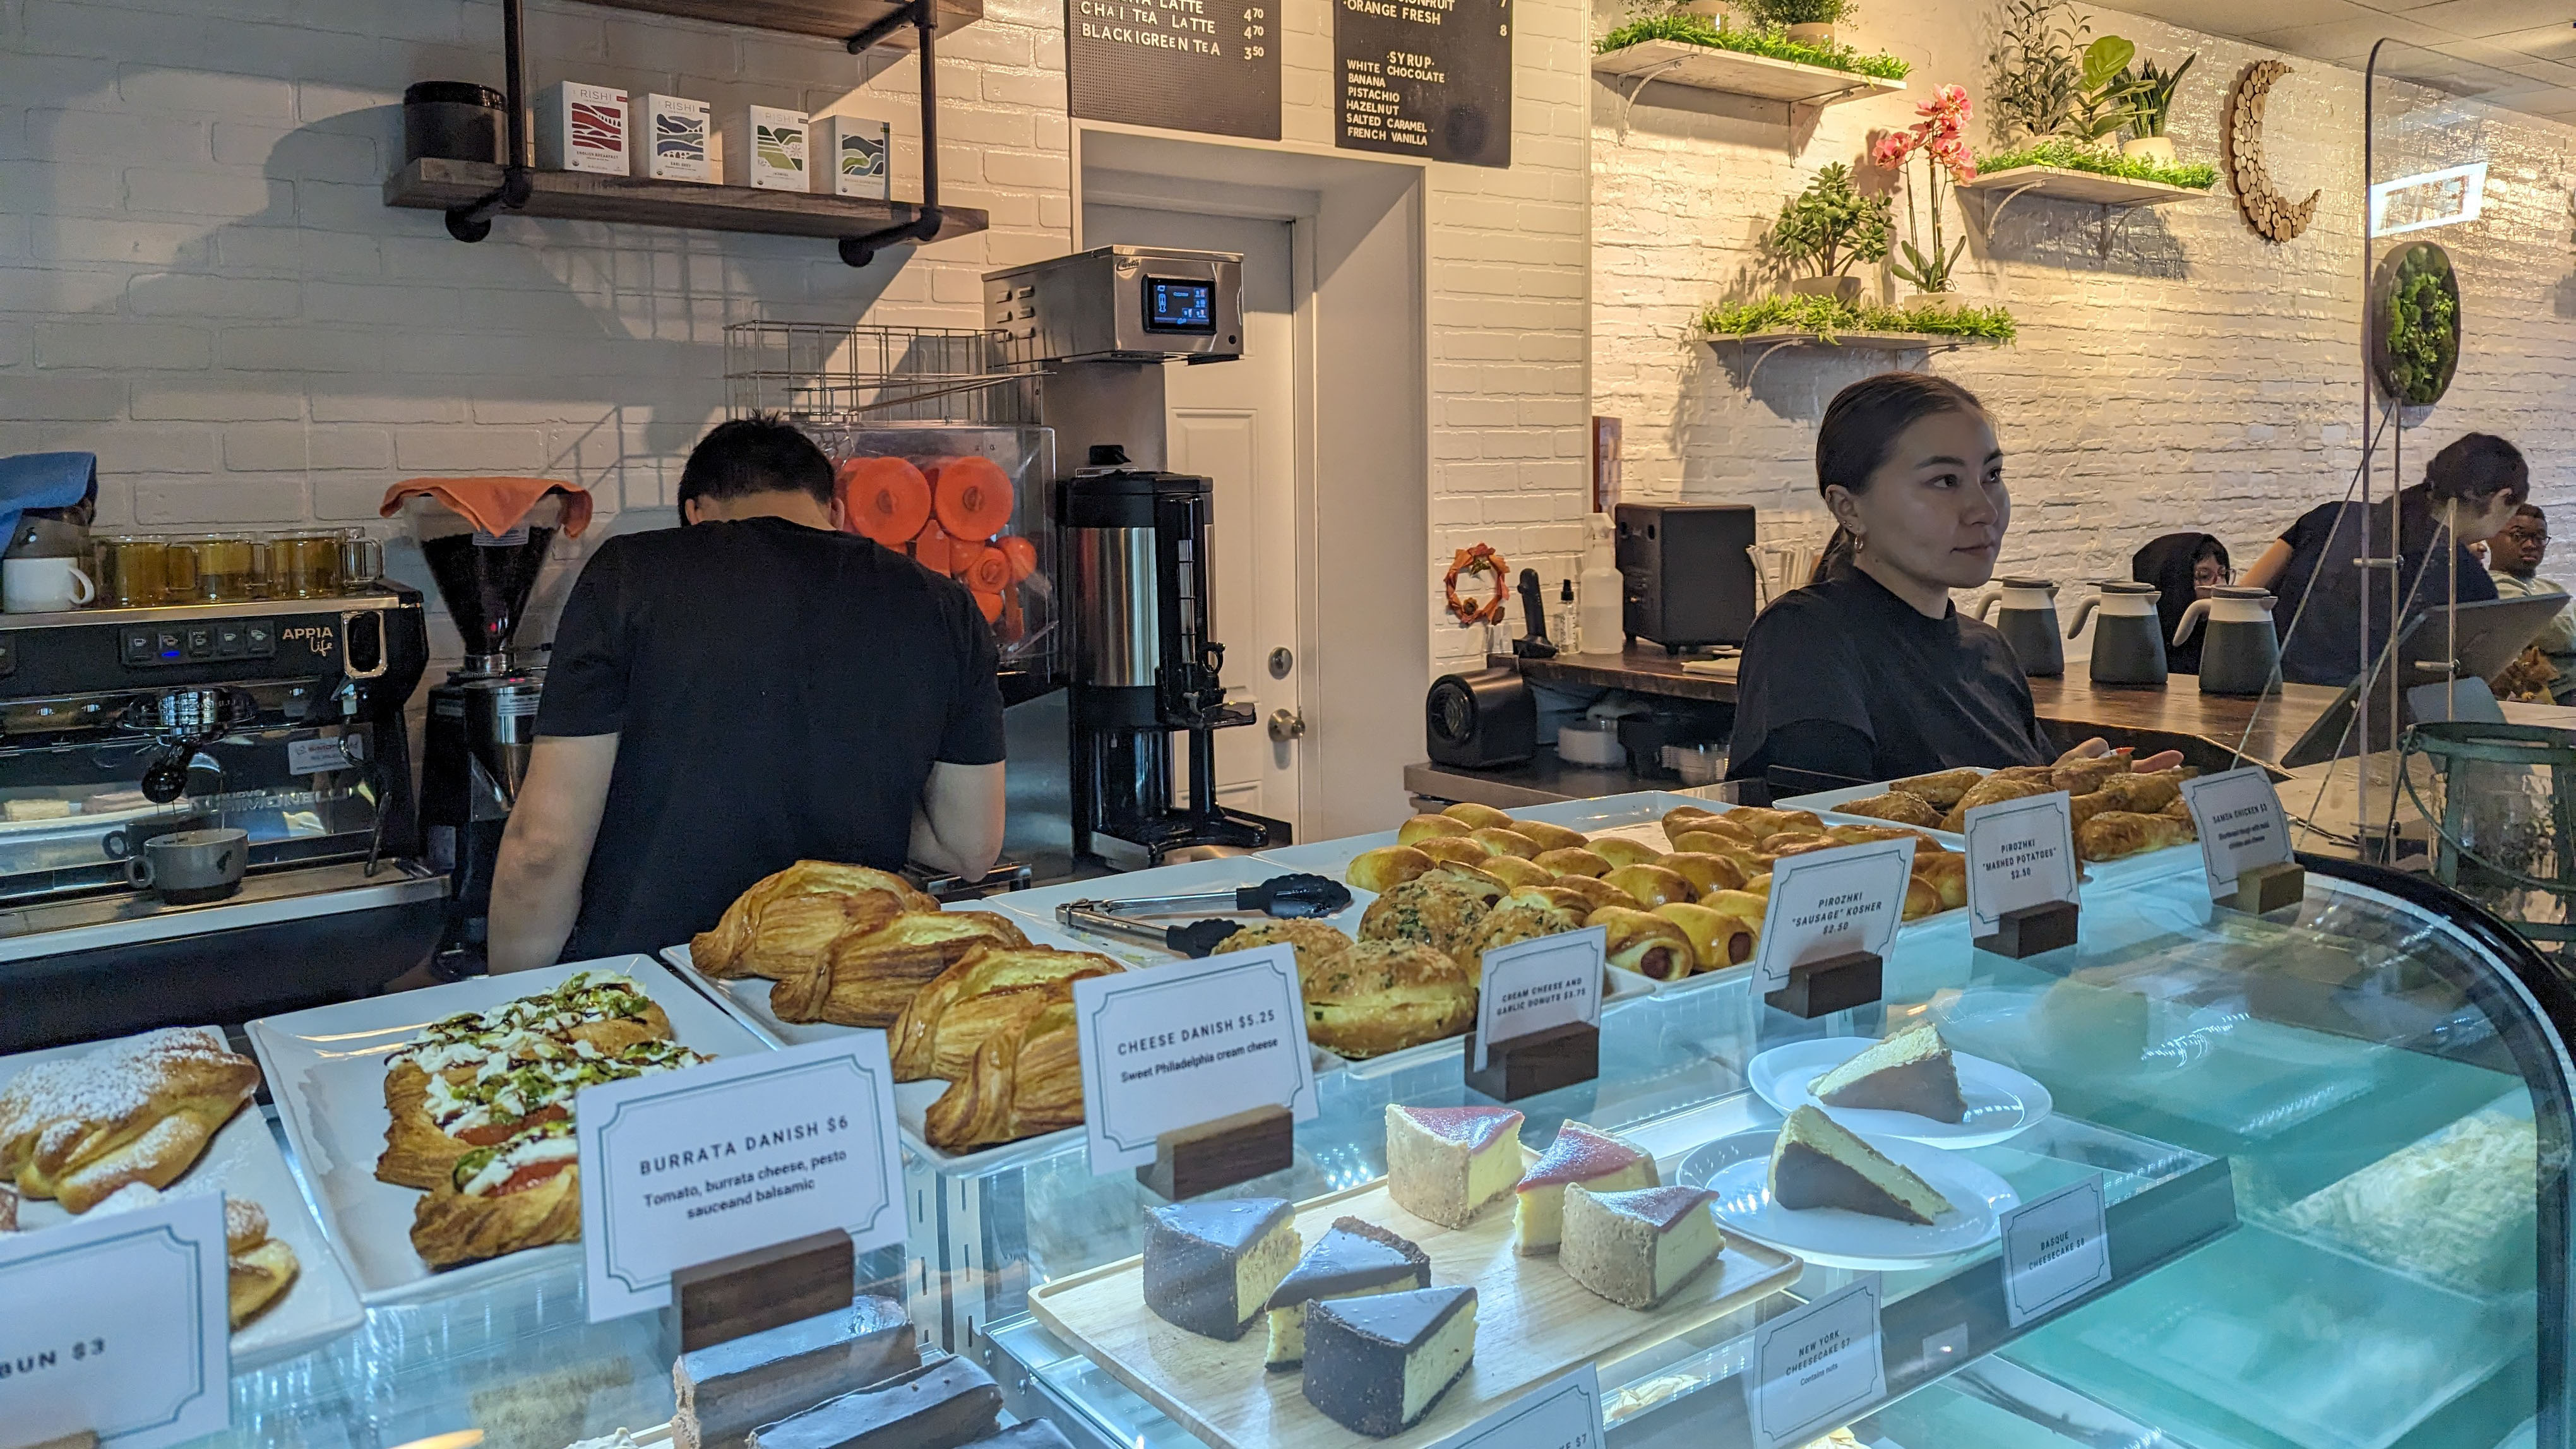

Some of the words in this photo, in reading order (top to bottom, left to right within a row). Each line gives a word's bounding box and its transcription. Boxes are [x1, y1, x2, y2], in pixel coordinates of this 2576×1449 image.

[1080, 1, 1123, 20] CHAI
[1132, 8, 1157, 25] TEA
[1172, 15, 1215, 33] LATTE
[1160, 0, 1204, 14] LATTE
[1402, 7, 1441, 25] FRESH
[1500, 25, 1507, 37] 8
[1193, 39, 1220, 56] TEA
[1347, 59, 1381, 73] WHITE
[1387, 65, 1445, 83] CHOCOLATE
[1348, 73, 1386, 88] BANANA
[580, 89, 612, 101] RISHI
[1348, 86, 1400, 102] PISTACHIO
[665, 100, 695, 112] RISHI
[1346, 99, 1399, 116] HAZELNUT
[1346, 113, 1381, 126] SALTED
[1386, 118, 1428, 133] CARAMEL
[1347, 126, 1386, 141] FRENCH
[1391, 131, 1428, 146] VANILLA
[1116, 257, 1140, 271] Curtis
[283, 627, 333, 640] APPIA
[309, 637, 333, 657] life
[2234, 805, 2259, 818] CHICKEN
[2001, 838, 2036, 853] PIROZHKI
[1983, 857, 2015, 871] "MASHED
[2017, 847, 2056, 863] POTATOES"
[2011, 867, 2031, 880] $2.50
[1818, 892, 1863, 908] PIROZHKI
[1792, 908, 1844, 927] "SAUSAGE"
[1846, 902, 1882, 916] KOSHER
[1823, 921, 1849, 935] $2.50
[1502, 988, 1529, 1002] CREAM
[1532, 981, 1563, 995] CHEESE
[1566, 977, 1582, 988] AND
[1496, 1001, 1525, 1016] GARLIC
[1528, 993, 1561, 1008] DONUTS
[1117, 1032, 1175, 1056] CHEESE
[1182, 1019, 1234, 1042] DANISH
[1238, 1010, 1275, 1029] $5.25
[1121, 1067, 1153, 1083] Sweet
[1155, 1051, 1214, 1076] Philadelphia
[1216, 1047, 1246, 1060] cream
[1247, 1038, 1279, 1053] cheese
[639, 1140, 737, 1176] BURRATA
[746, 1121, 820, 1152] DANISH
[826, 1114, 849, 1133] $6
[643, 1185, 703, 1208] Tomato,
[705, 1171, 755, 1194] burrata
[757, 1159, 809, 1181] cheese,
[811, 1148, 847, 1171] pesto
[687, 1191, 753, 1219] sauceand
[756, 1177, 816, 1202] balsamic
[2040, 1231, 2069, 1251] BASQUE
[2029, 1243, 2075, 1270] CHEESECAKE
[1799, 1342, 1816, 1357] NEW
[1819, 1330, 1840, 1345] YORK
[0, 1350, 56, 1378] BUN
[72, 1337, 105, 1361] $3
[1786, 1344, 1839, 1376] CHEESECAKE
[1841, 1337, 1851, 1350] $7
[1800, 1370, 1825, 1386] Contains
[1826, 1363, 1838, 1374] nuts
